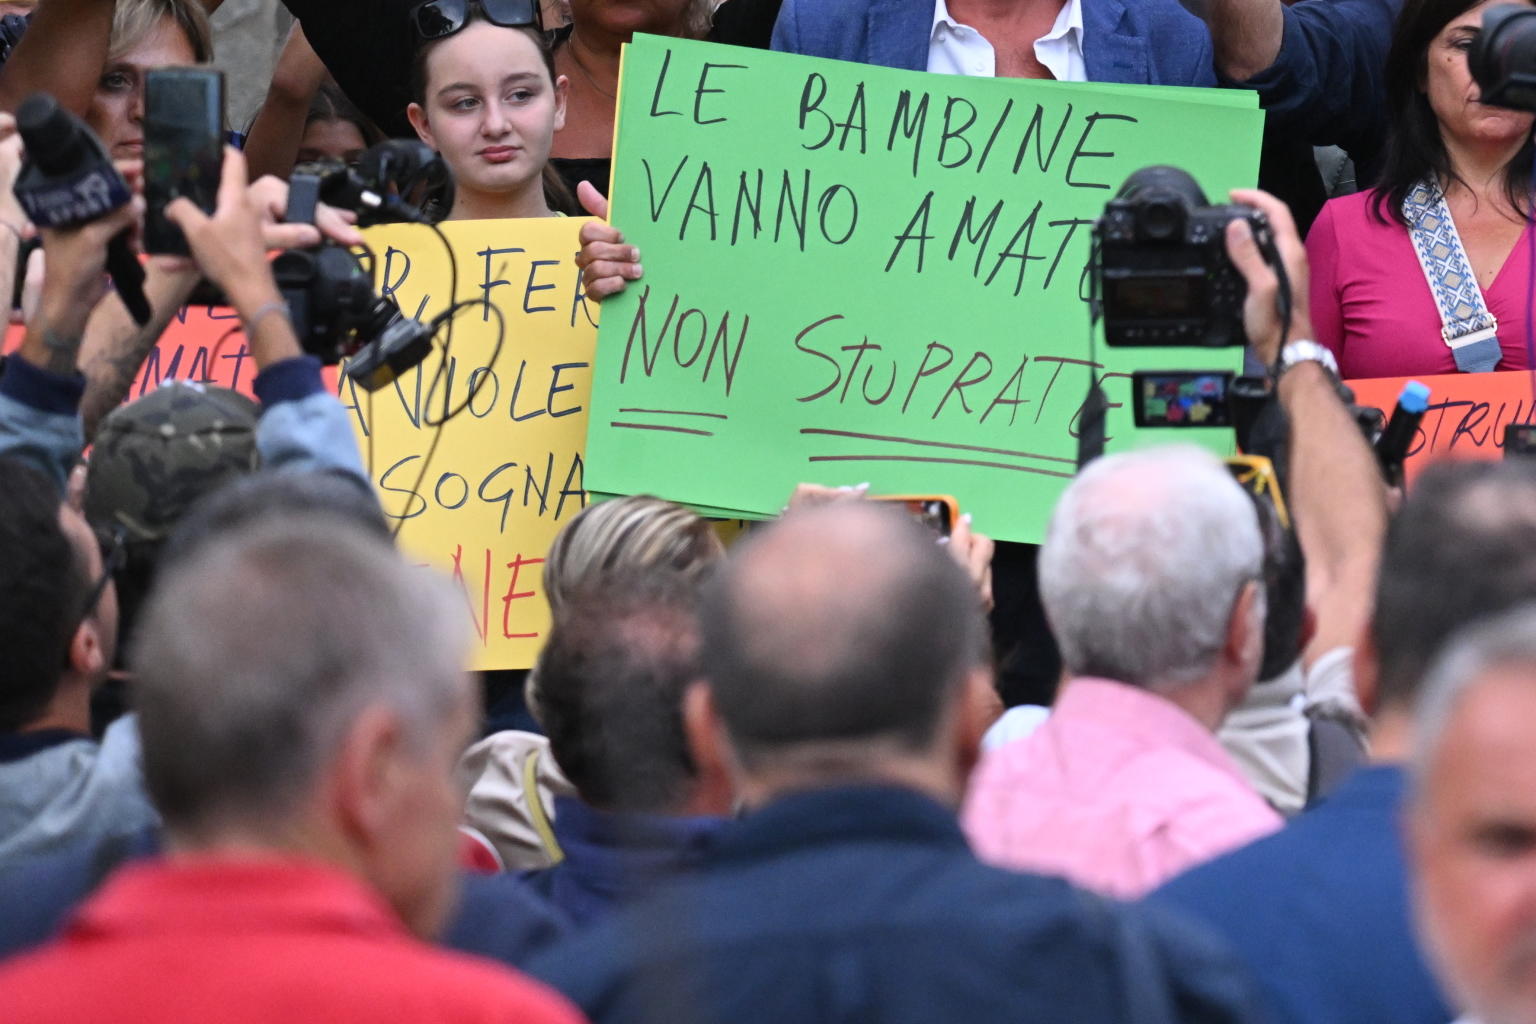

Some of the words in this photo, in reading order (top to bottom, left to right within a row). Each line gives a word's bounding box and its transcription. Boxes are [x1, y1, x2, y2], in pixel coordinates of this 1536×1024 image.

[649, 49, 749, 125] LE
[798, 71, 1139, 190] BAMBINE
[641, 154, 859, 253] VANNO
[619, 283, 750, 398] NON
